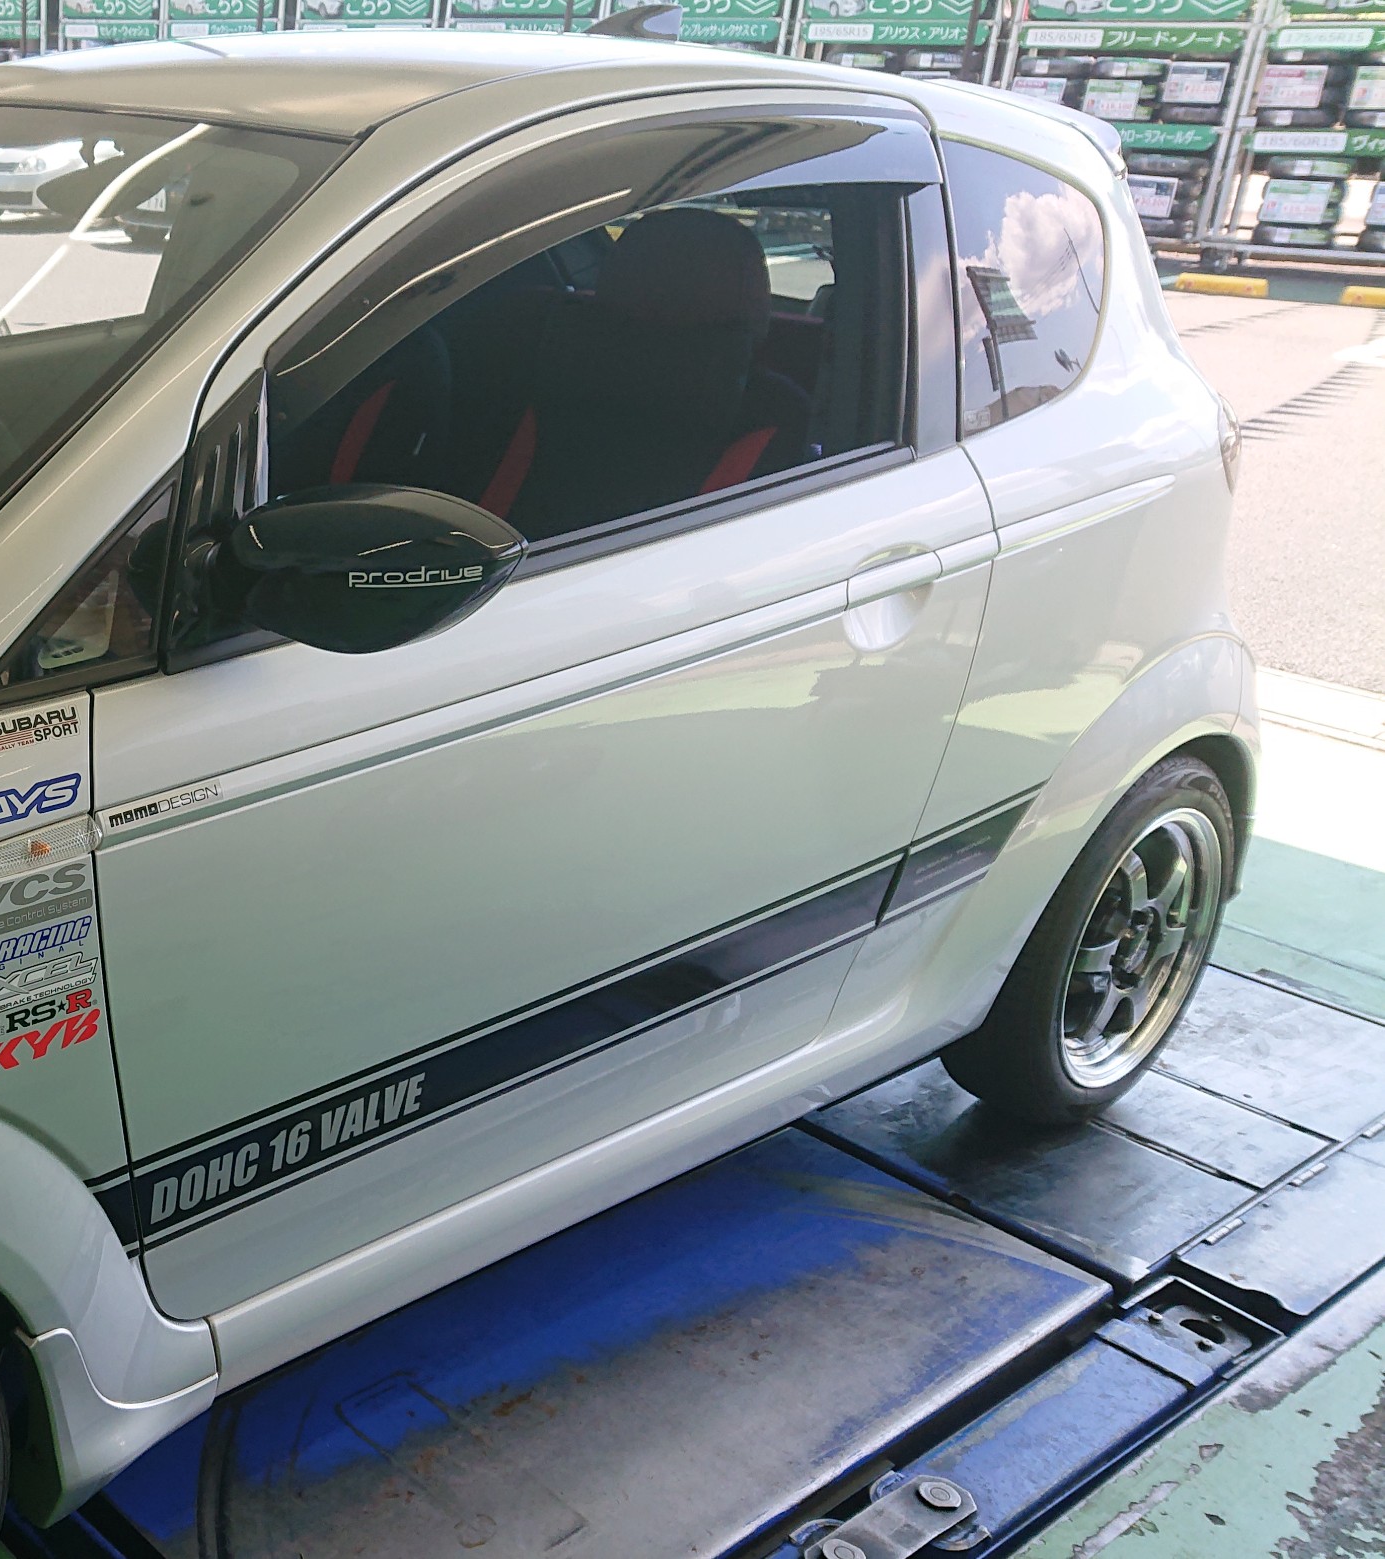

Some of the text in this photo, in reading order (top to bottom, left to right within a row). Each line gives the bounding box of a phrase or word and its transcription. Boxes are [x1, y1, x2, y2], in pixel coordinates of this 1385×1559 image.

[1107, 30, 1232, 48] フリード・ノート
[348, 565, 483, 588] prodrive
[17, 739, 35, 747] TEAM
[34, 722, 79, 742] SPORT
[7, 909, 46, 926] Control
[48, 896, 88, 914] System
[33, 976, 94, 999] TECHNOLOGY
[150, 1072, 426, 1225] DOHC 16 VALVE
